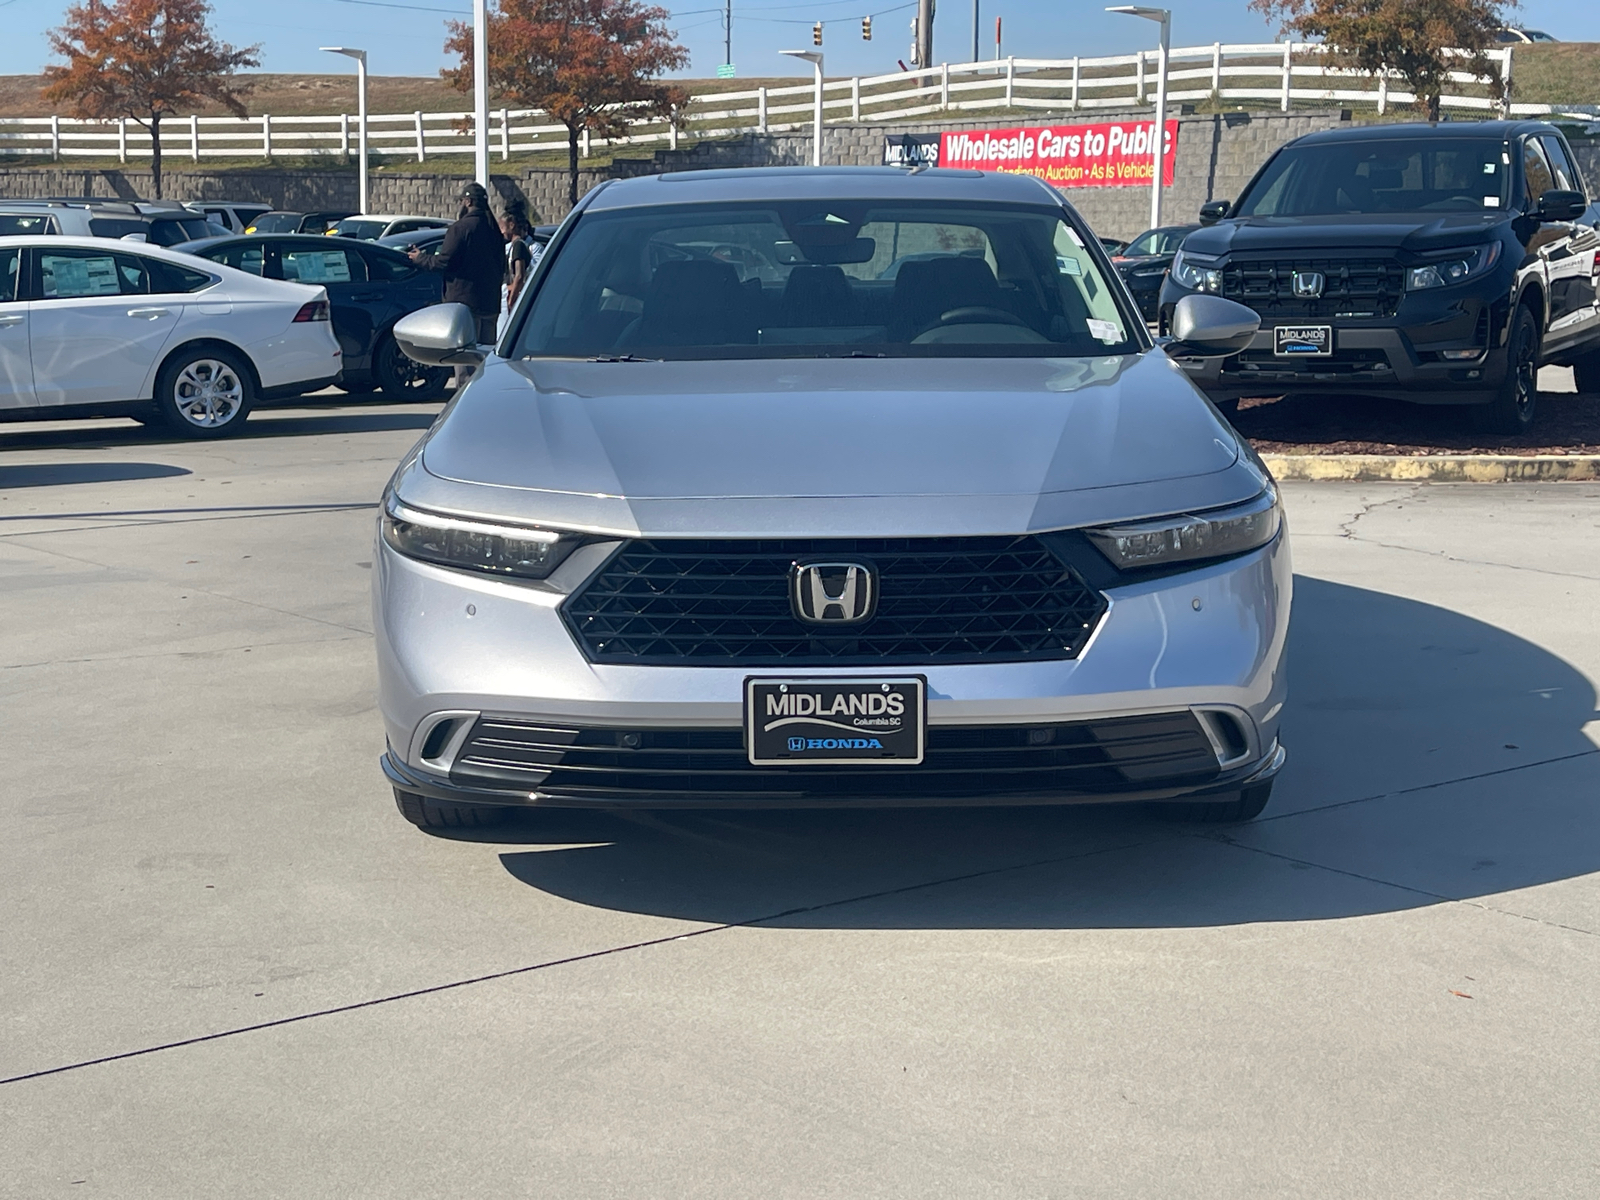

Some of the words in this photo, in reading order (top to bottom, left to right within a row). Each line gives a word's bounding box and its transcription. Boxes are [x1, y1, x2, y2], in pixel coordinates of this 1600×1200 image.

[885, 143, 938, 162] MIDLANDS
[947, 131, 1034, 161] Wholesale
[1037, 129, 1081, 159] Cars
[1083, 129, 1105, 156] to
[1045, 164, 1083, 181] Auction
[1090, 162, 1104, 179] As
[1105, 162, 1115, 179] Is
[1116, 161, 1155, 179] Vehicle
[1280, 330, 1325, 339] MIDLANDS
[766, 692, 905, 716] MIDLANDS
[853, 717, 889, 726] Columbia
[889, 717, 902, 726] SC
[806, 738, 884, 749] HONDA
